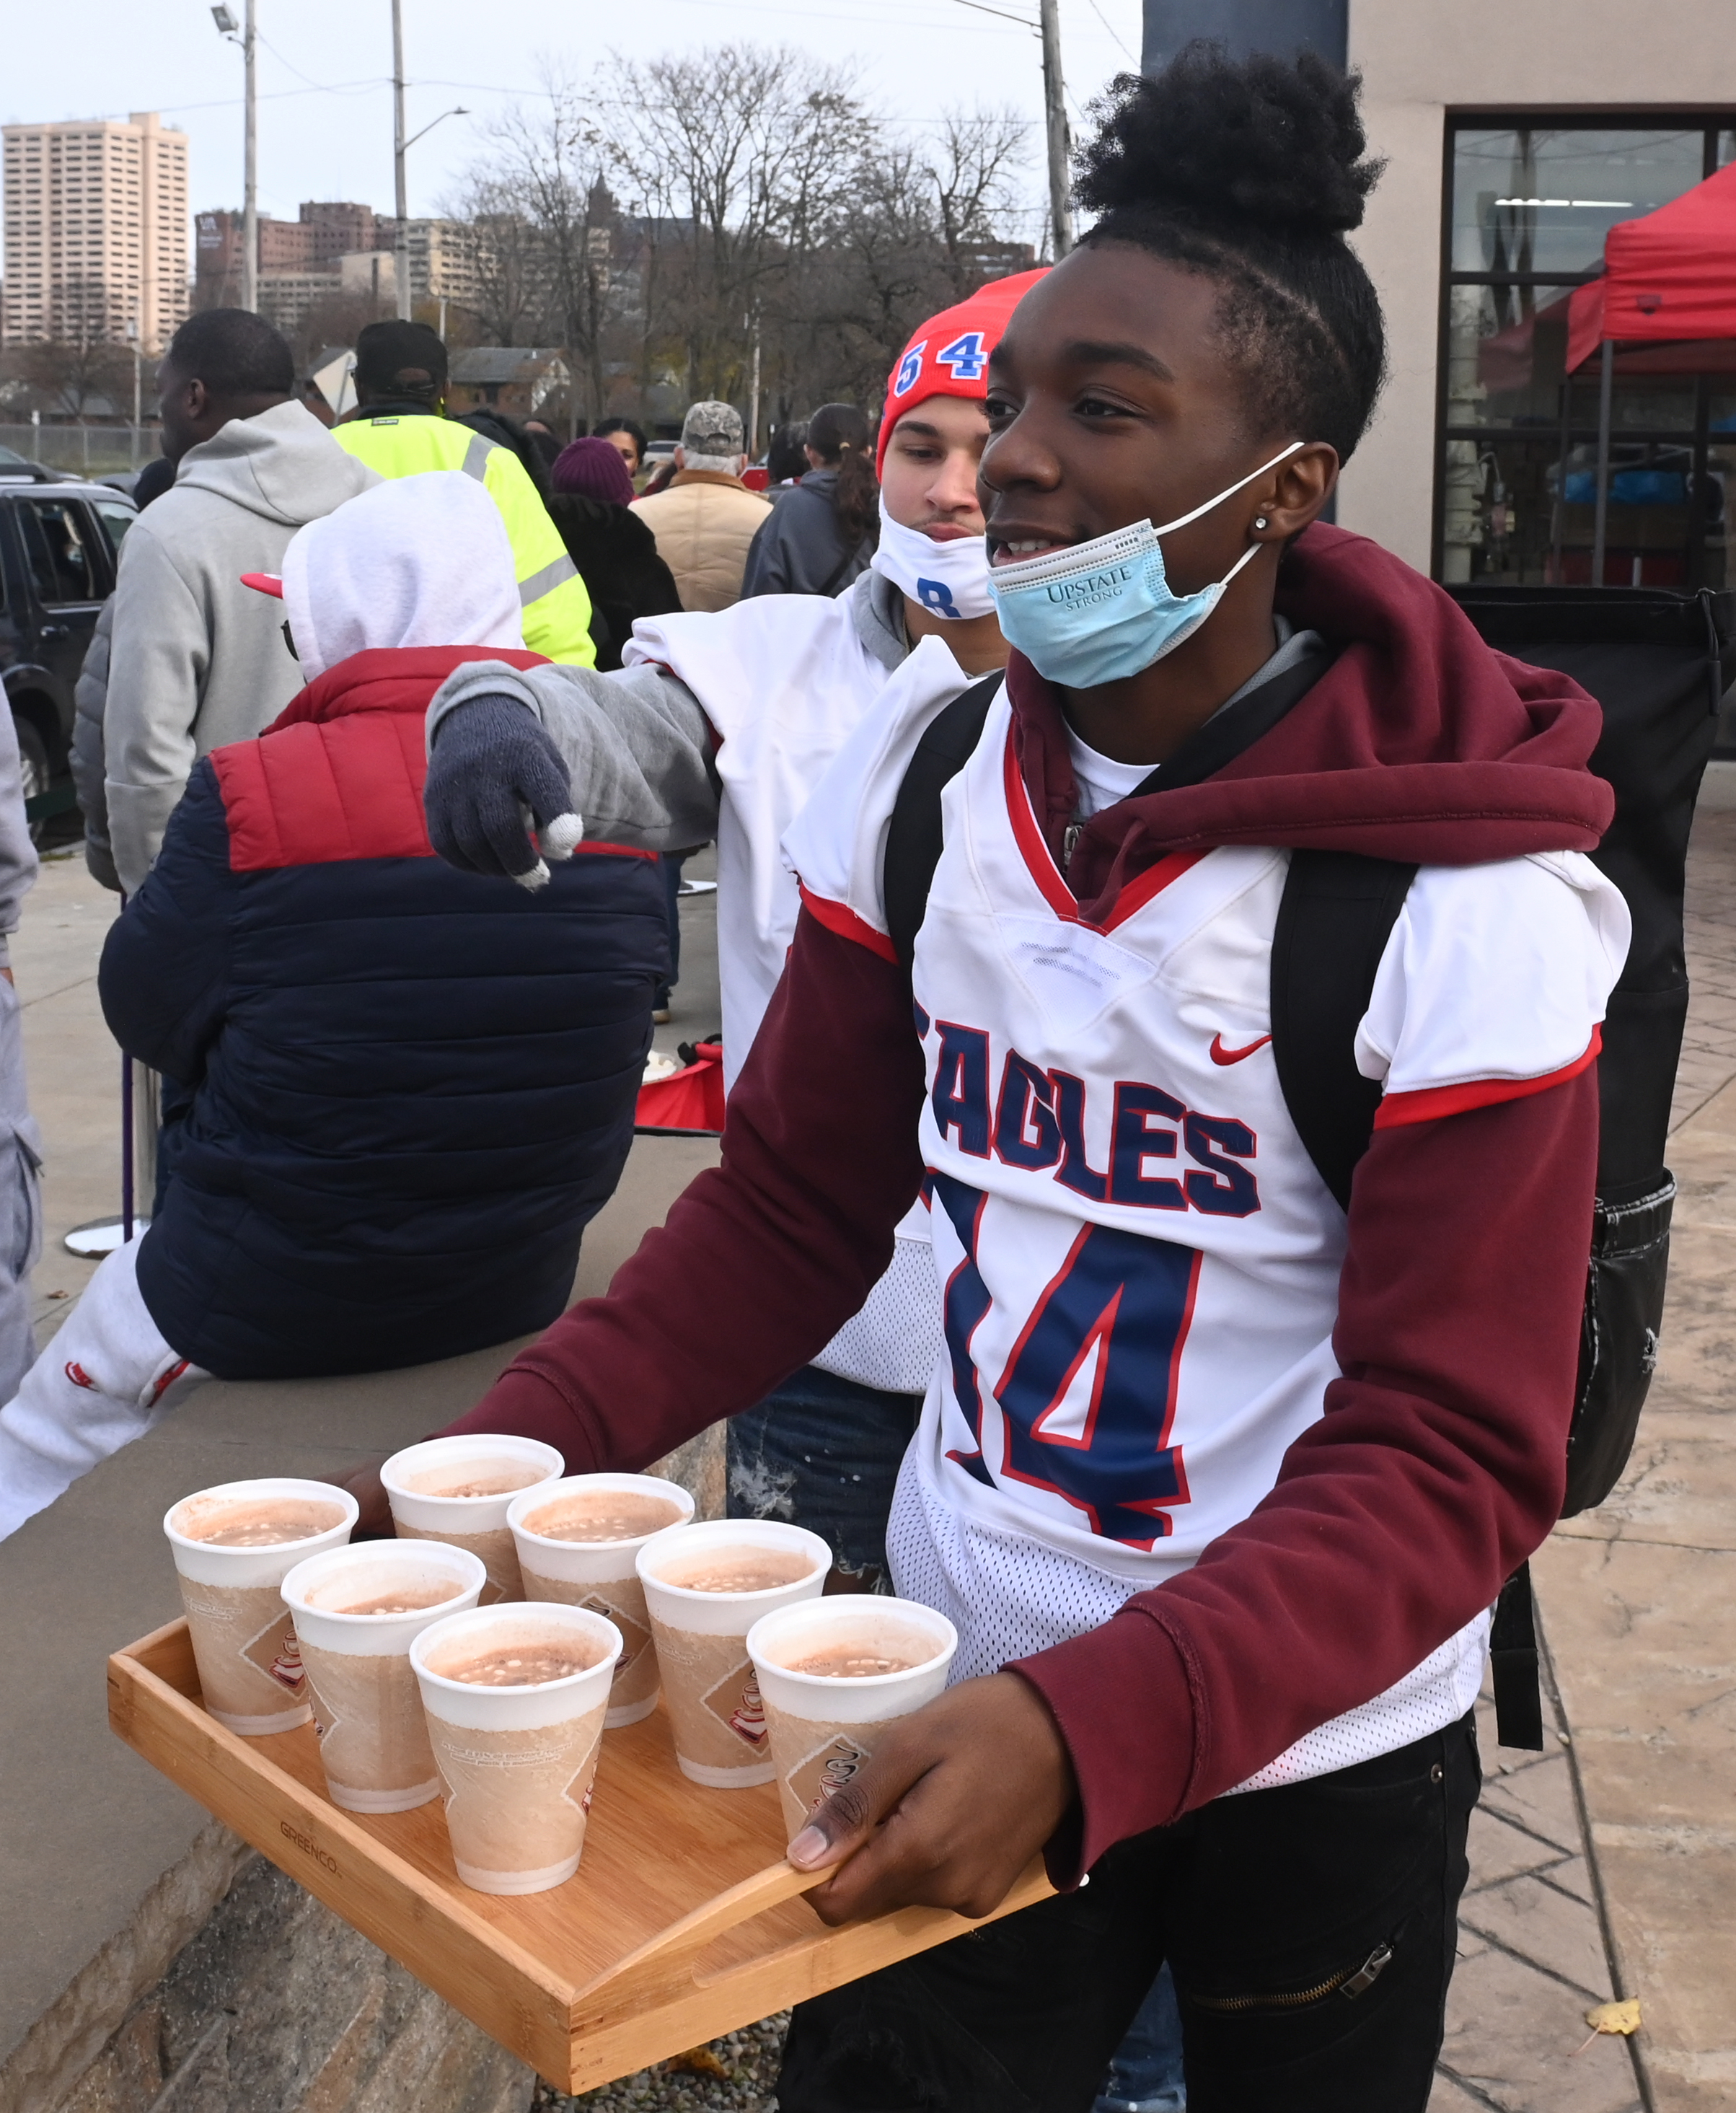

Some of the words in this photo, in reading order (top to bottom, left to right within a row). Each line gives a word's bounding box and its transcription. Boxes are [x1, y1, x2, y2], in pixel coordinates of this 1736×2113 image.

[917, 577, 962, 618] R
[1047, 566, 1132, 603] UPSTATE
[1066, 586, 1122, 612] STRONG
[915, 1001, 1261, 1218] AGLES
[920, 1167, 1191, 1552] 14
